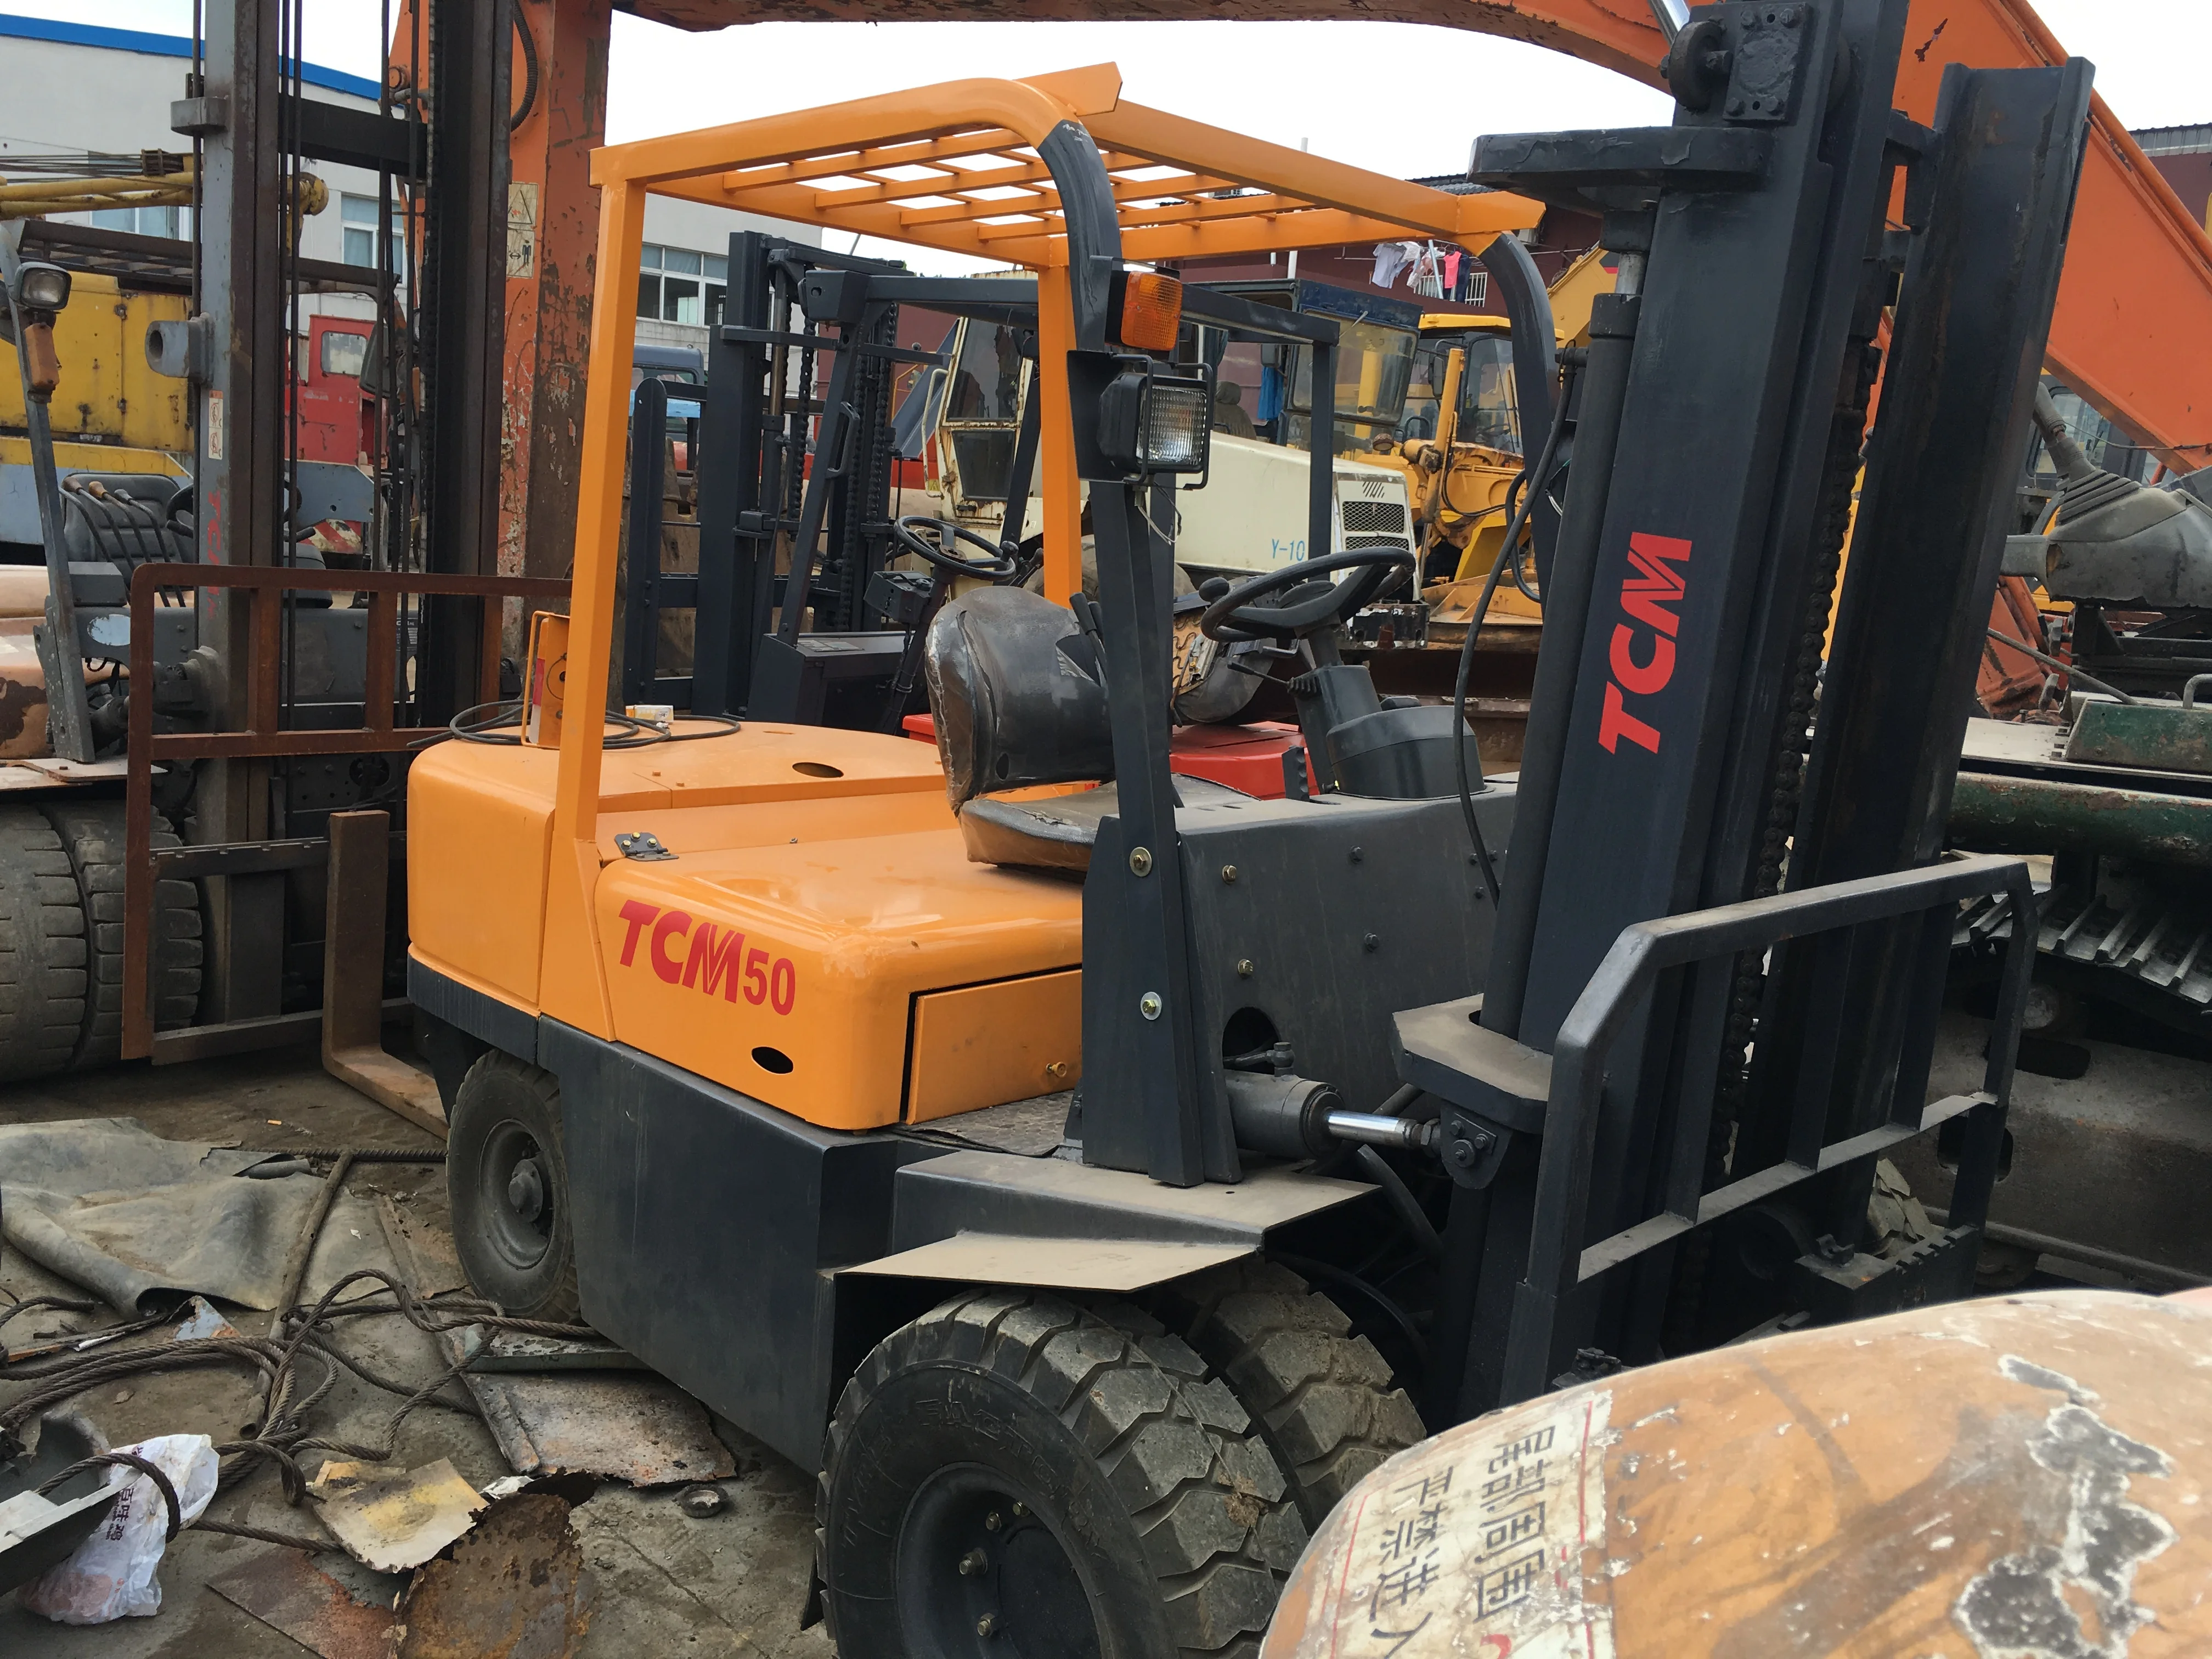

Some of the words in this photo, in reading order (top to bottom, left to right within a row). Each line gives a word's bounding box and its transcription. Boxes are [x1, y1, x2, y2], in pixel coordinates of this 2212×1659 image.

[1271, 538, 1305, 561] Y-10
[1598, 532, 1692, 754] TCM
[1472, 1425, 1556, 1623] 尾部周围
